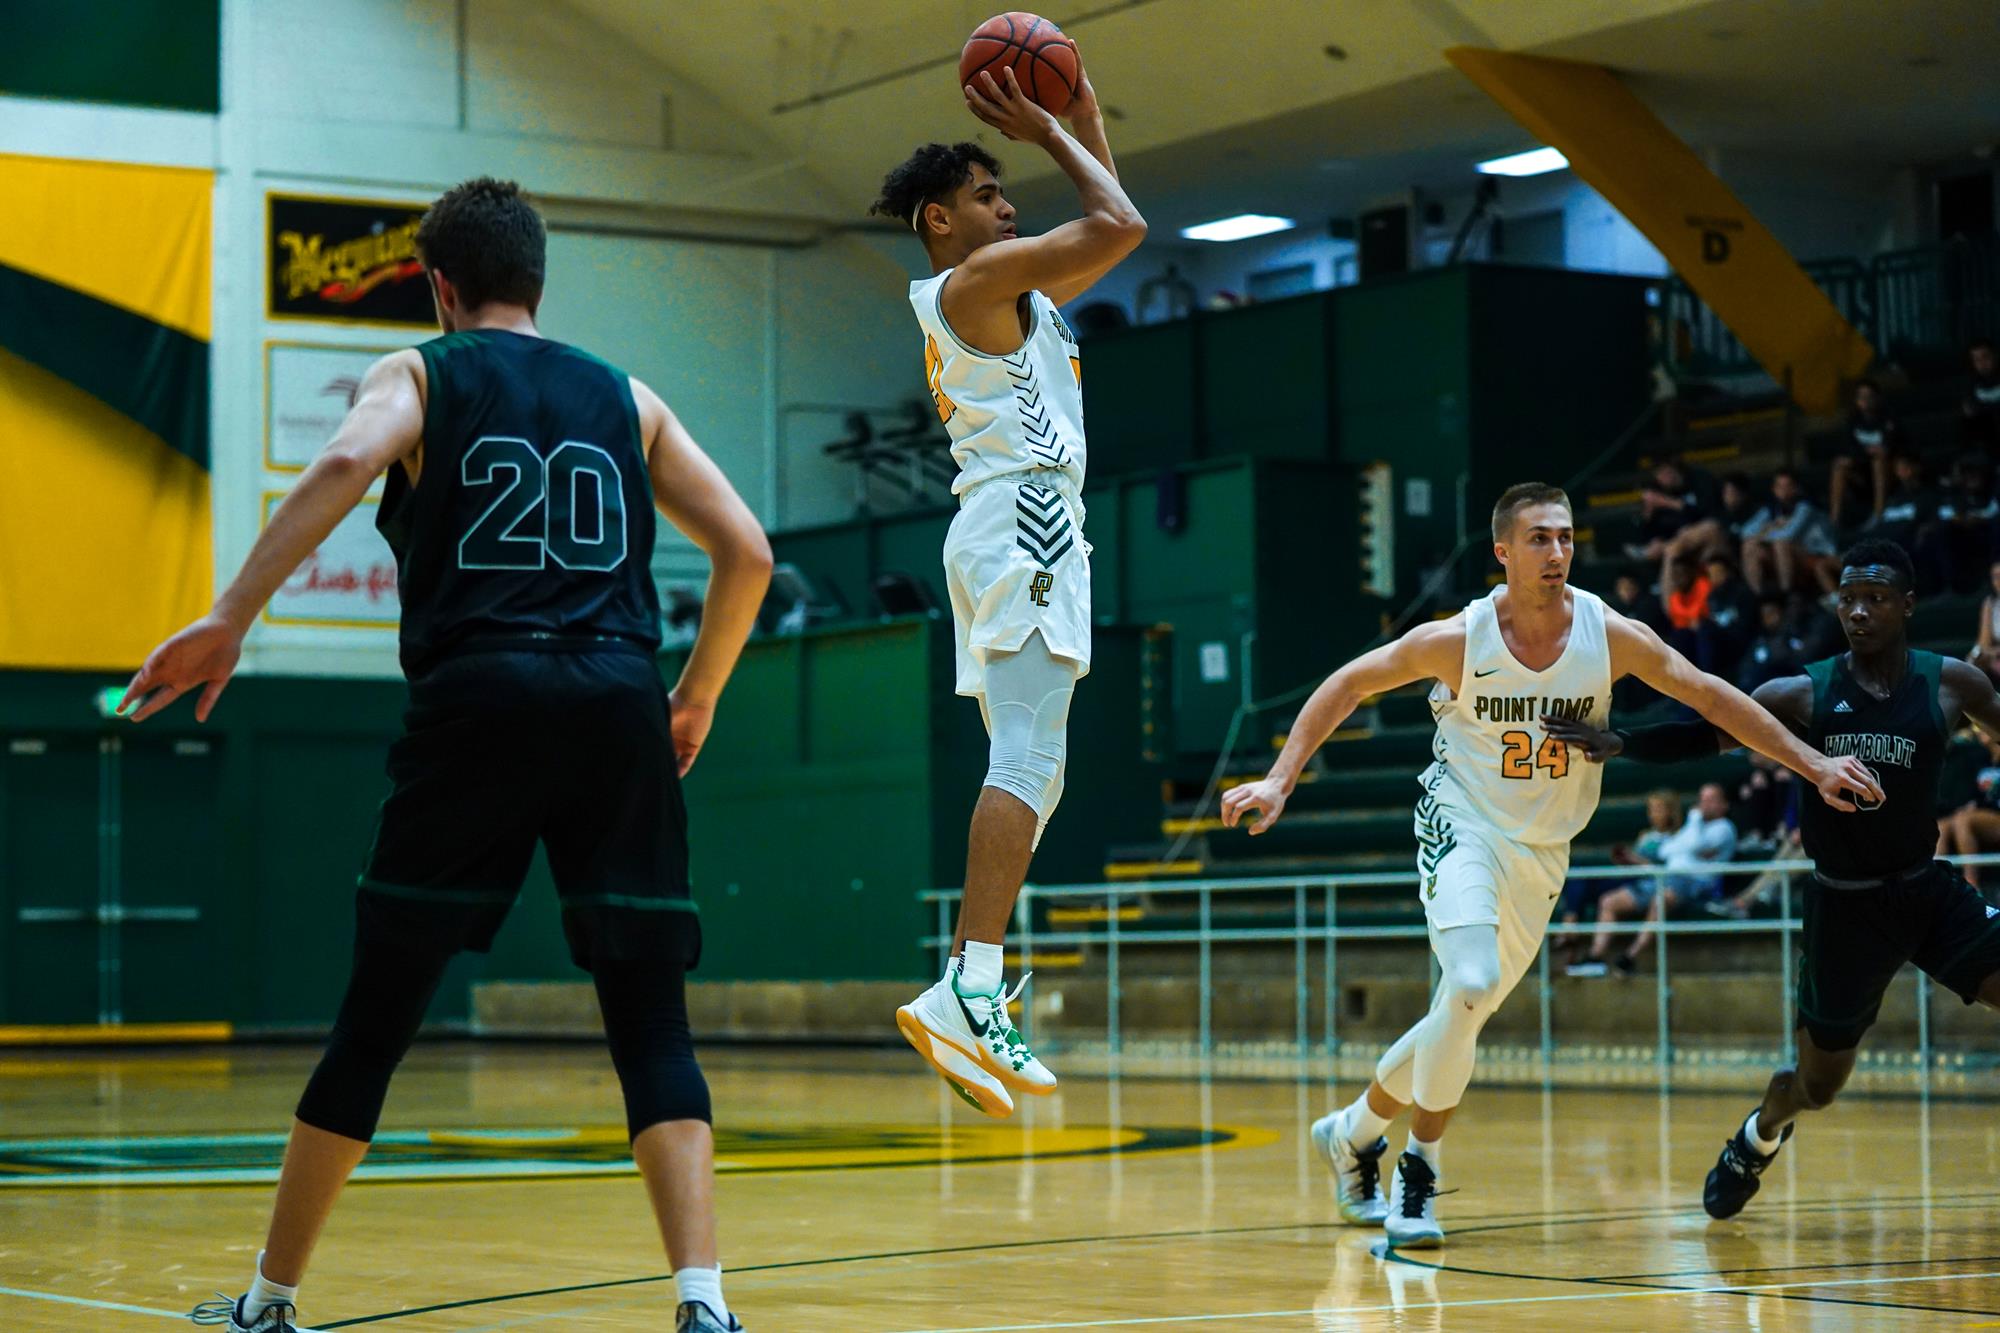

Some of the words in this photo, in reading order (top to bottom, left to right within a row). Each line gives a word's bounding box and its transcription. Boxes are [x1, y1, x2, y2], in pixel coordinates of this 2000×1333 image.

[1702, 231, 1729, 264] D
[458, 436, 628, 572] 20
[1474, 695, 1537, 722] POINT
[1501, 730, 1569, 779] 24
[1825, 733, 1916, 768] HUMBOLDT
